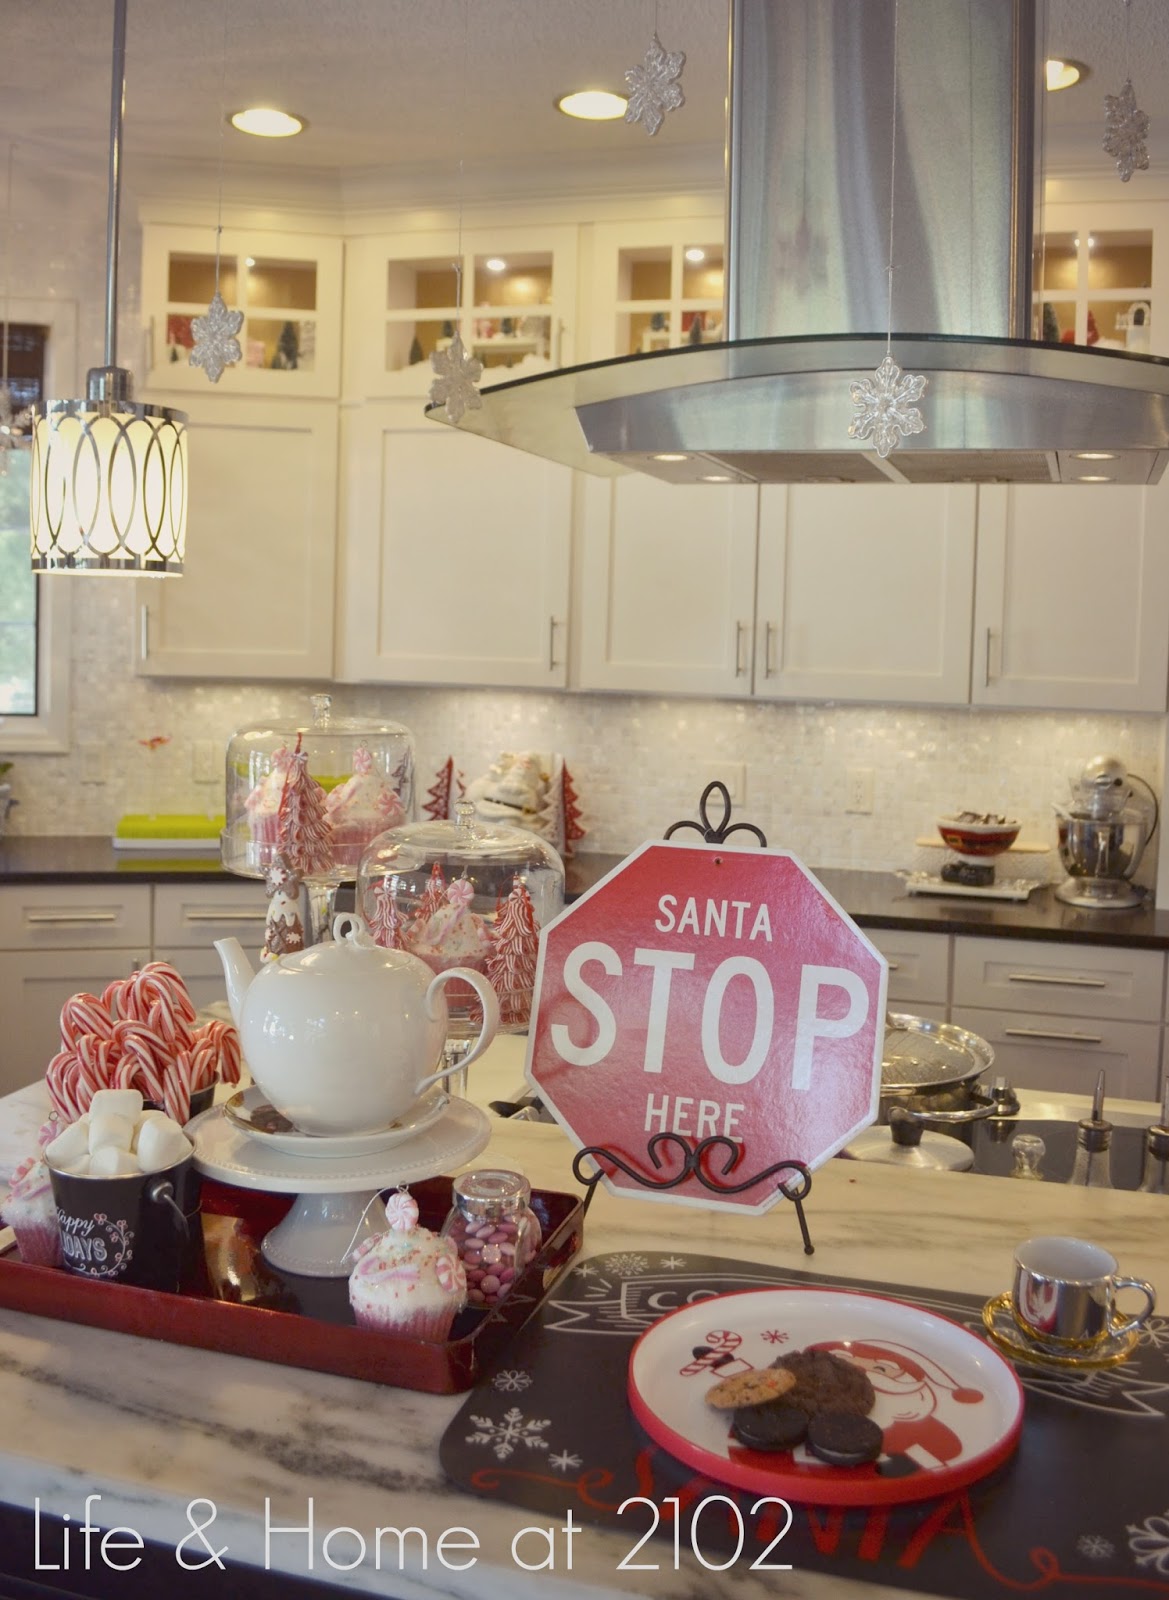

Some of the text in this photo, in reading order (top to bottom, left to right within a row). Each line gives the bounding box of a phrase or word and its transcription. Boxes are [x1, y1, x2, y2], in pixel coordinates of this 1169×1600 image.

[655, 894, 773, 942] SANTA
[550, 941, 870, 1091] STOP
[644, 1093, 745, 1144] HERE
